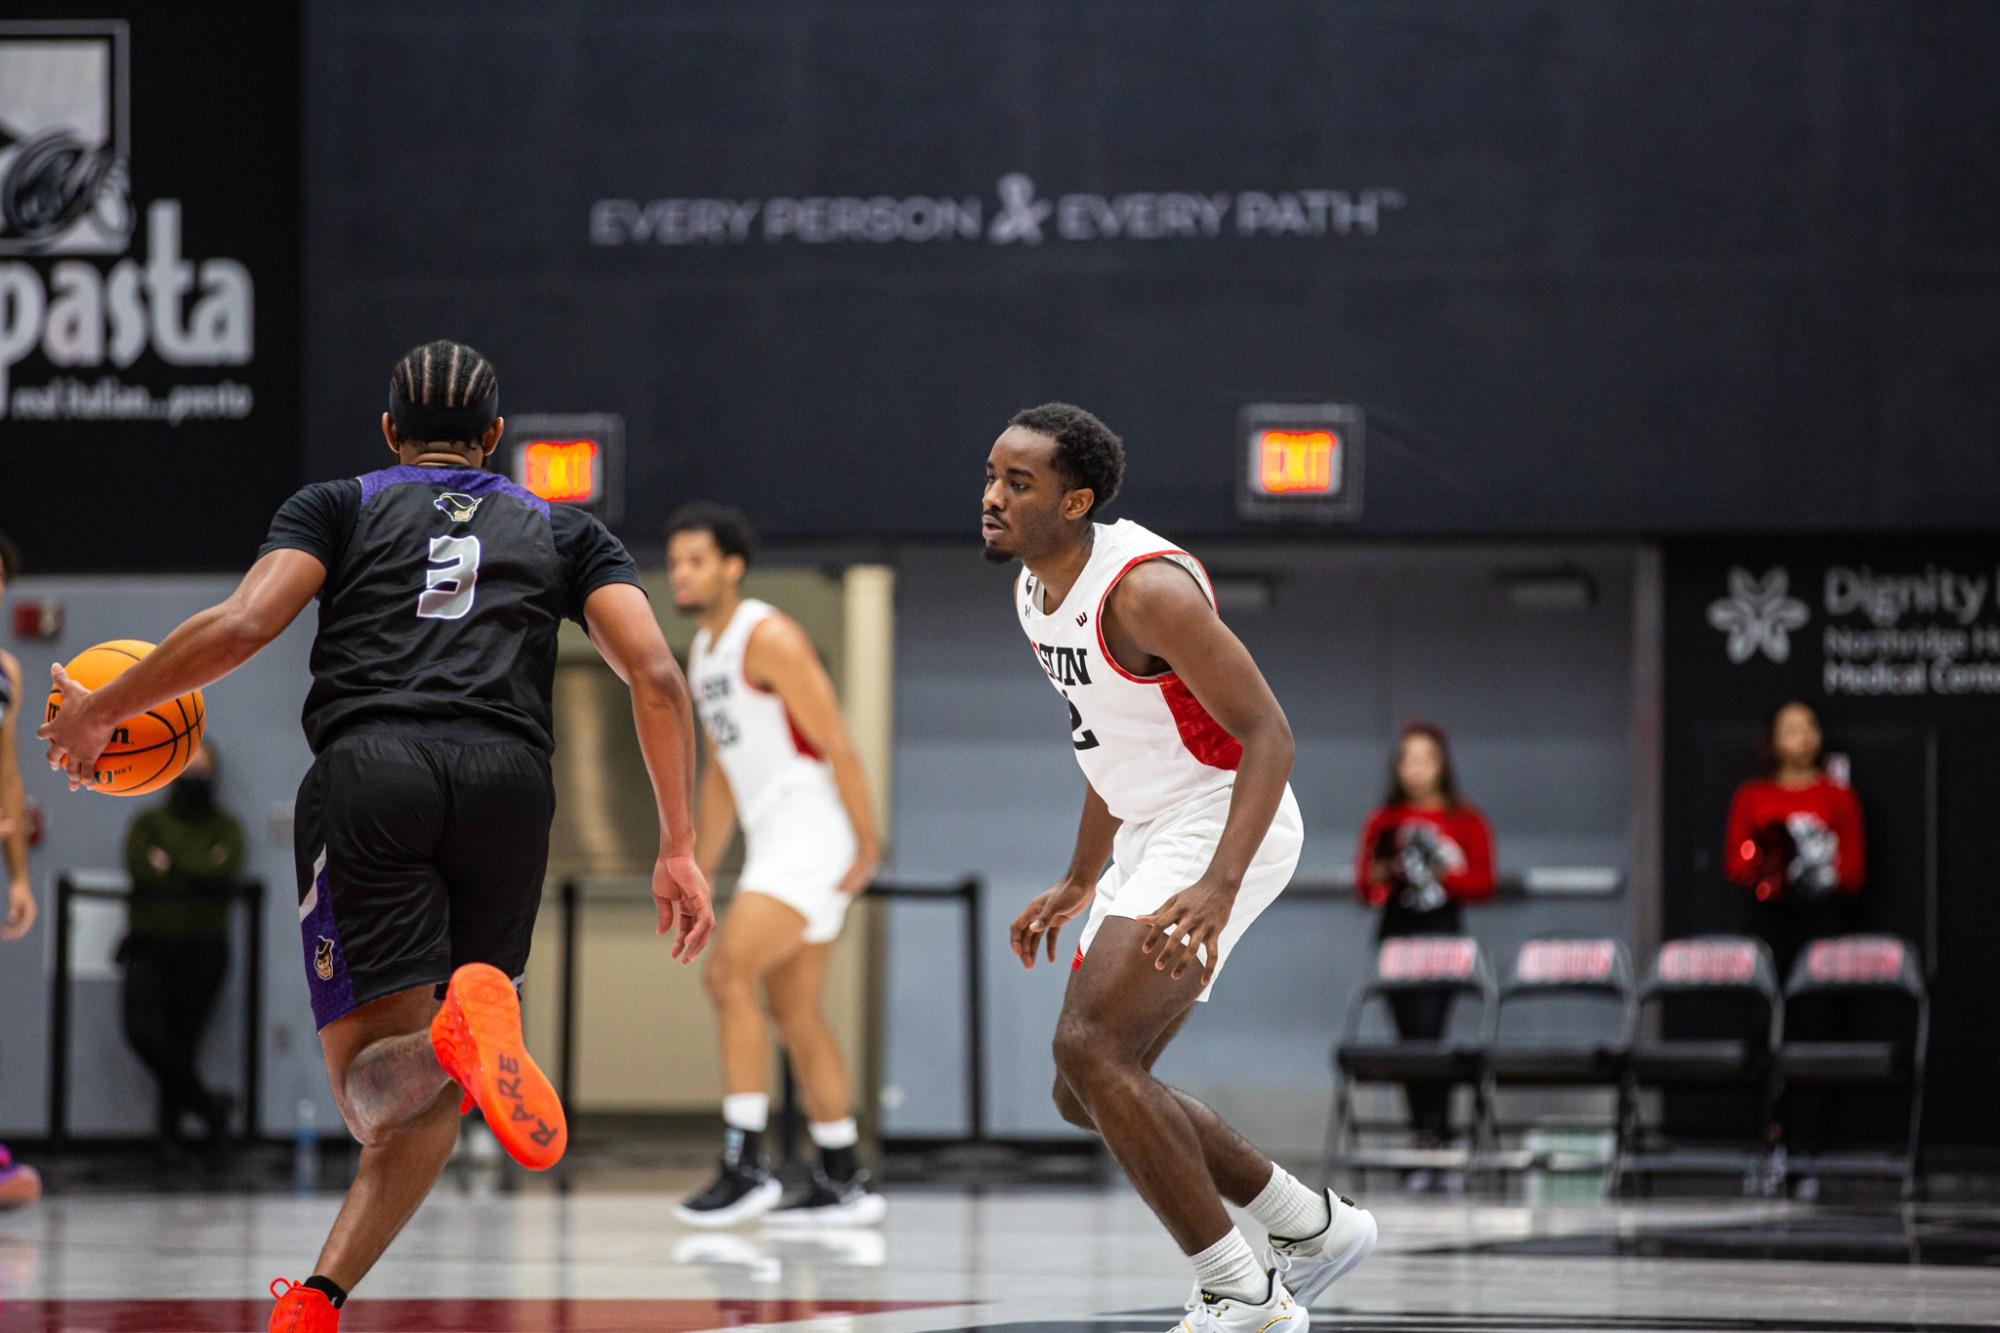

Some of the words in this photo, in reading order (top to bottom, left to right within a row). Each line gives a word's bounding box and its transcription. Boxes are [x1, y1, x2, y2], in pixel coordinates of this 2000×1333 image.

[590, 198, 759, 246] EVERY
[762, 195, 982, 244] PERSON
[988, 173, 1050, 244] &
[1056, 191, 1229, 239] EVERY
[0, 198, 254, 420] pasta
[416, 534, 481, 620] 3
[1823, 563, 1988, 628] Dignity
[498, 1053, 559, 1148] RARE
